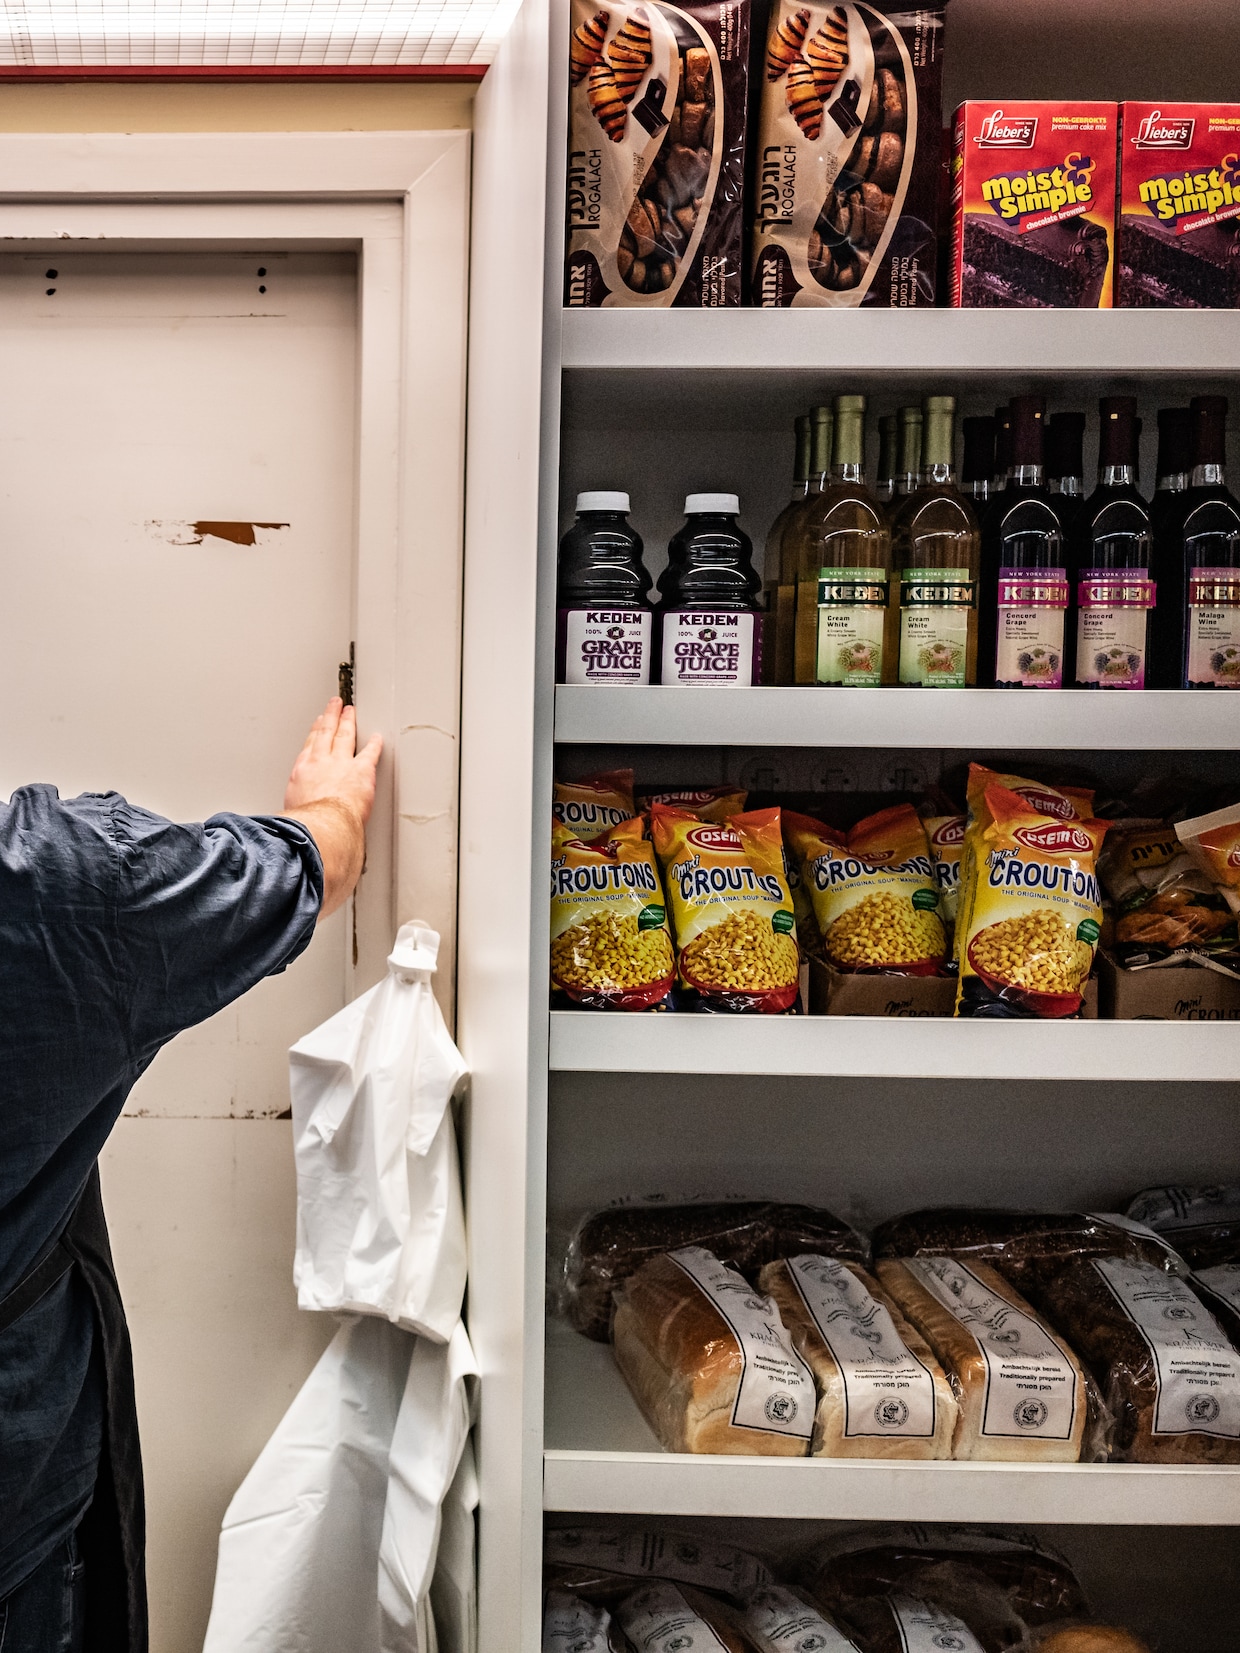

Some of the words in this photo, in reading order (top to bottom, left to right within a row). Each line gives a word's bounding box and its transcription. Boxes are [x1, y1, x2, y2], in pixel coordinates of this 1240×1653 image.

[973, 109, 1031, 145] Lieber's
[1051, 123, 1078, 131] premium
[1079, 123, 1094, 131] cake
[1131, 110, 1188, 145] Lieber's
[1062, 151, 1097, 187] &
[588, 149, 601, 222] ROGALACH
[782, 145, 796, 217] ROGALACH
[1026, 215, 1058, 231] chocolate
[1058, 204, 1087, 219] brownie
[1183, 216, 1215, 232] chocolate
[910, 258, 919, 277] Pastry
[909, 278, 917, 305] Flavored
[907, 587, 972, 600] KEDEM
[586, 612, 642, 624] KEDEM
[679, 614, 738, 626] KEDEM
[581, 640, 643, 656] GRAPE
[674, 642, 740, 658] GRAPE
[581, 654, 642, 672] JUICE
[674, 656, 739, 673] JUICE
[845, 880, 876, 889] ORIGINAL
[572, 895, 604, 903] ORIGINAL
[709, 896, 740, 904] ORIGINAL
[1017, 890, 1050, 900] ORIGINAL
[1052, 895, 1070, 903] SOUP
[999, 1373, 1037, 1381] Traditionally
